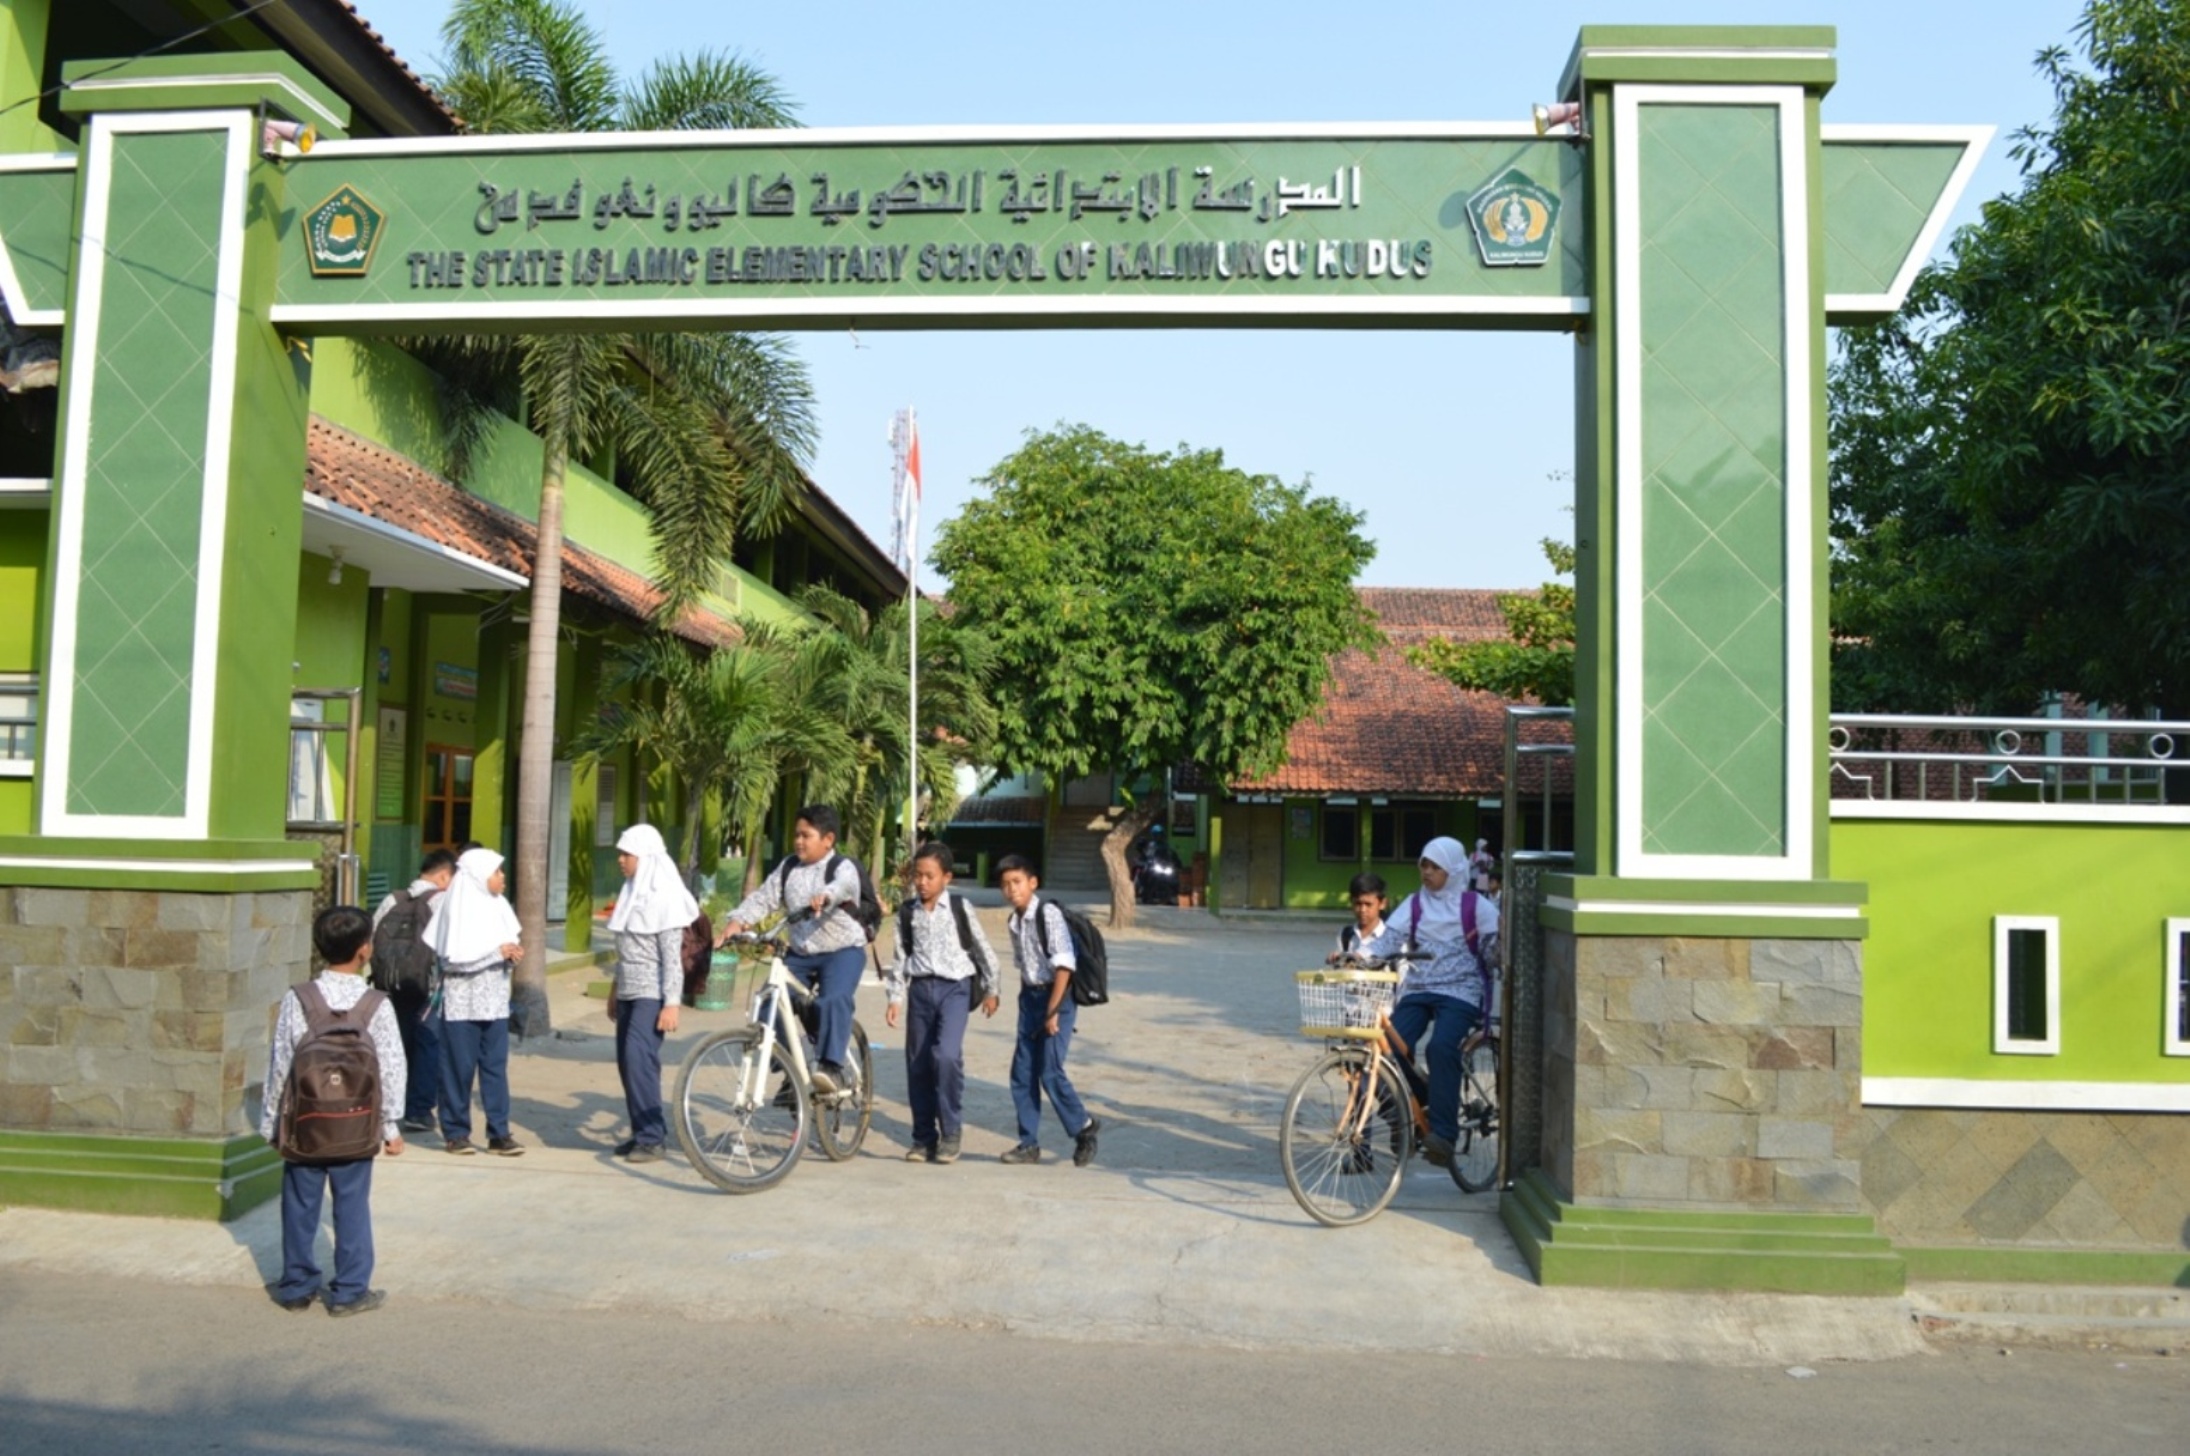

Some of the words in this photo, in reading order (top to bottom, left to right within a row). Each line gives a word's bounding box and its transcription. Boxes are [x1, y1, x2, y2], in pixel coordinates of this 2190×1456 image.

[1193, 165, 1361, 222] المدرسة
[407, 250, 464, 289] THE
[472, 249, 564, 288] STATE
[571, 247, 699, 286] ISLAMIC
[705, 245, 909, 285] ELEMENTARY
[917, 243, 1047, 282] SCHOOL
[1055, 241, 1097, 281] OF
[1107, 239, 1306, 281] KALIWUNGU
[1316, 238, 1433, 278] KUDUS
